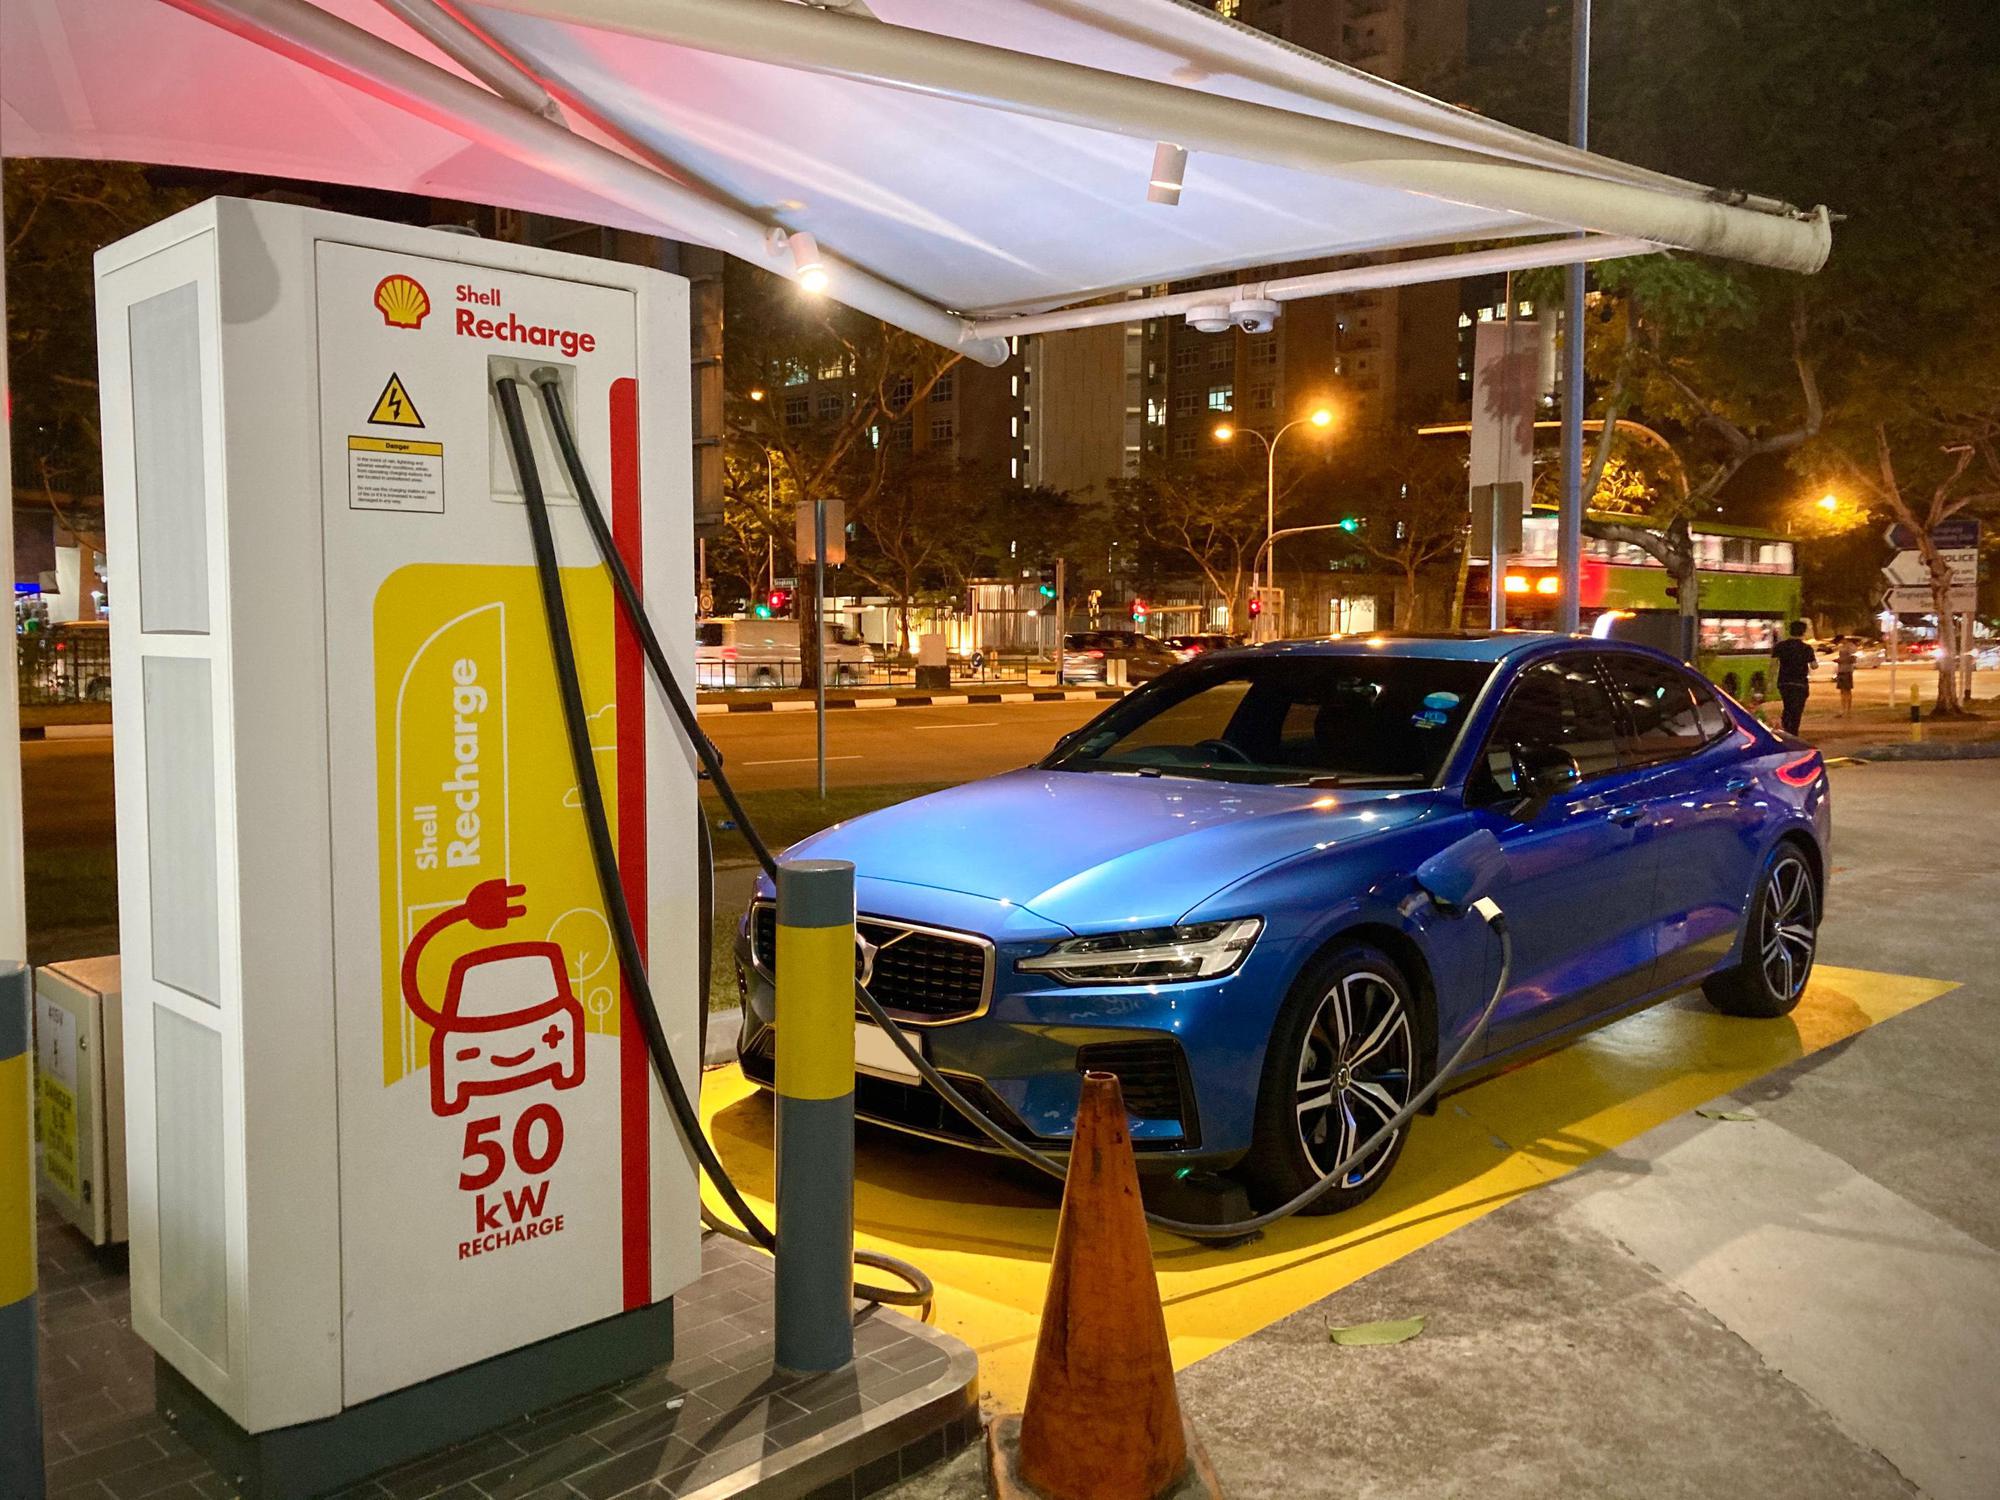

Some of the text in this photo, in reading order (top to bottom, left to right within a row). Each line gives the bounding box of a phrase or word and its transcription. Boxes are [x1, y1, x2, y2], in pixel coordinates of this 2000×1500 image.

[456, 284, 501, 307] Shell
[455, 307, 596, 358] Recharge
[385, 442, 410, 451] Danger
[442, 658, 488, 868] Recharge
[414, 804, 438, 870] Shell
[459, 1103, 564, 1191] 50
[475, 1180, 550, 1234] kW
[458, 1214, 565, 1261] RECHARGE
